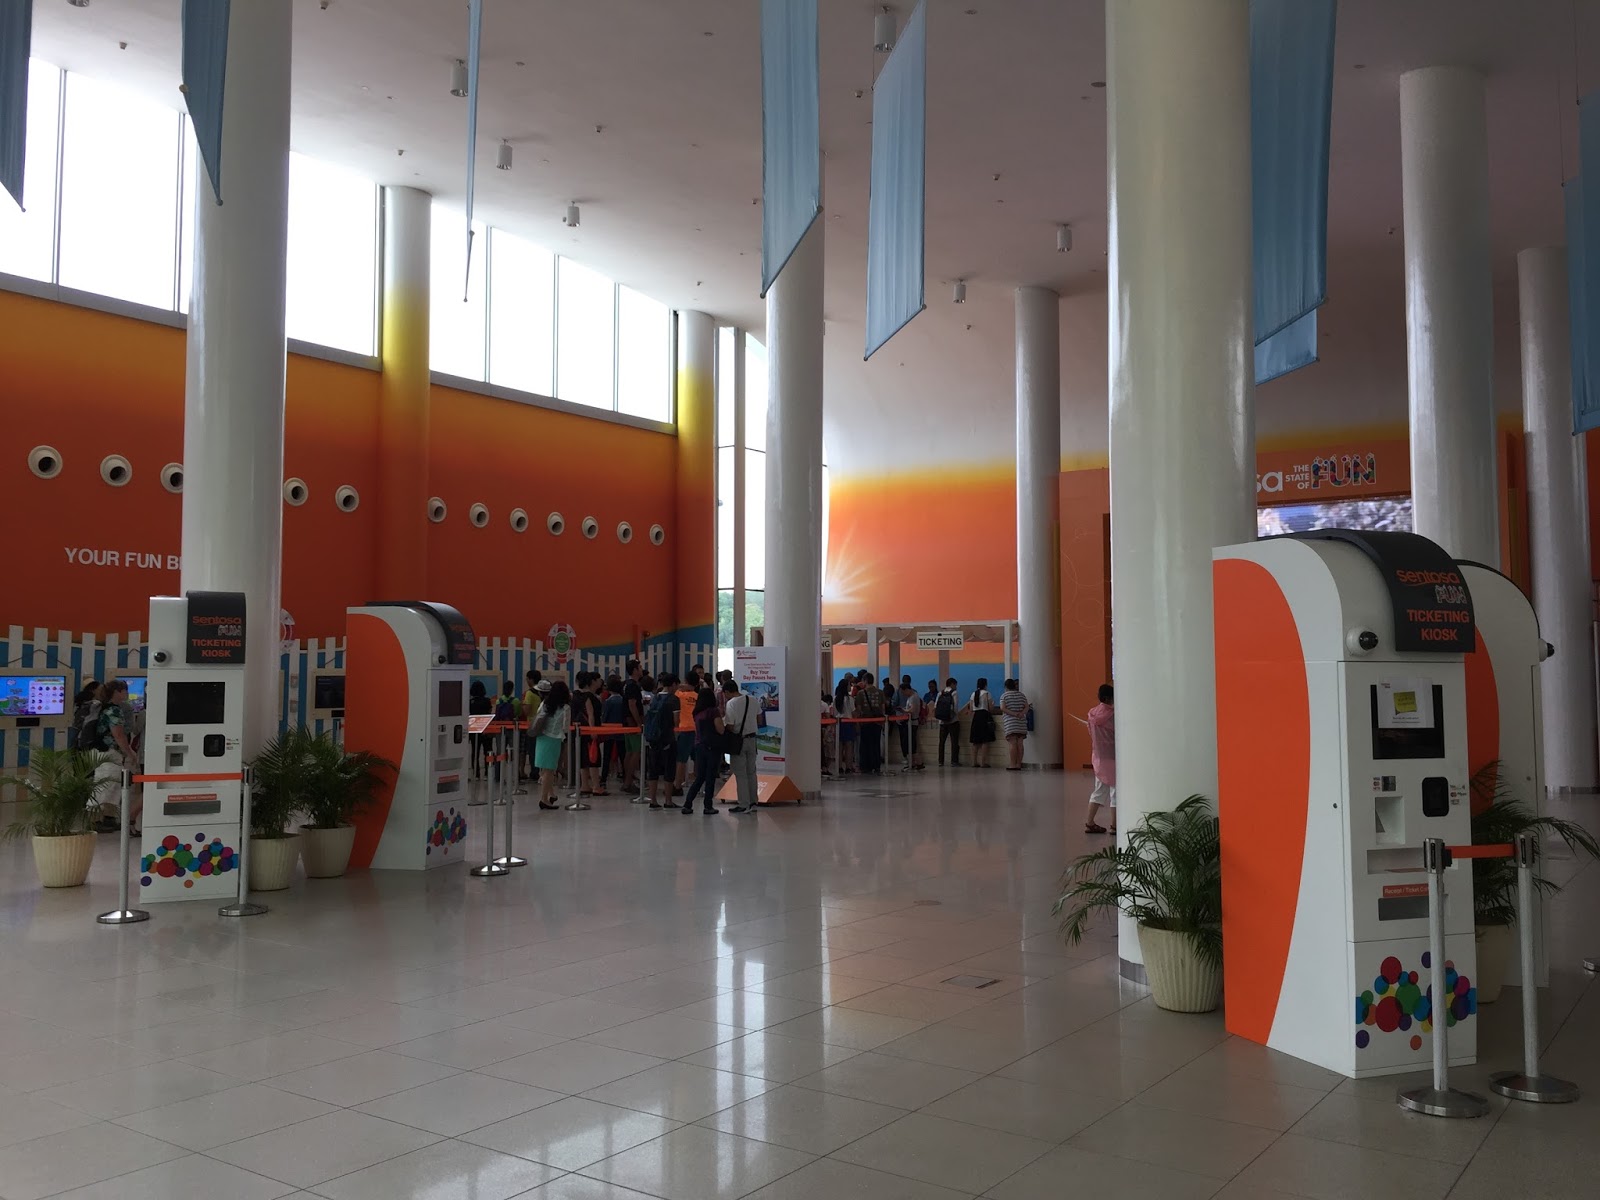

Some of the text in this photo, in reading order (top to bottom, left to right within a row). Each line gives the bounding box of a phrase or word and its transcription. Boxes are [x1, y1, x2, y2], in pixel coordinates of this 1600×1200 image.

[1293, 464, 1309, 472] THE
[1311, 453, 1376, 489] FUN
[1285, 473, 1309, 482] STATE
[64, 547, 182, 571] YOUR FUN B
[1407, 609, 1469, 623] TICKETING
[1421, 628, 1458, 641] KIOSK
[192, 639, 242, 647] TICKETING
[919, 637, 962, 646] TICKETING
